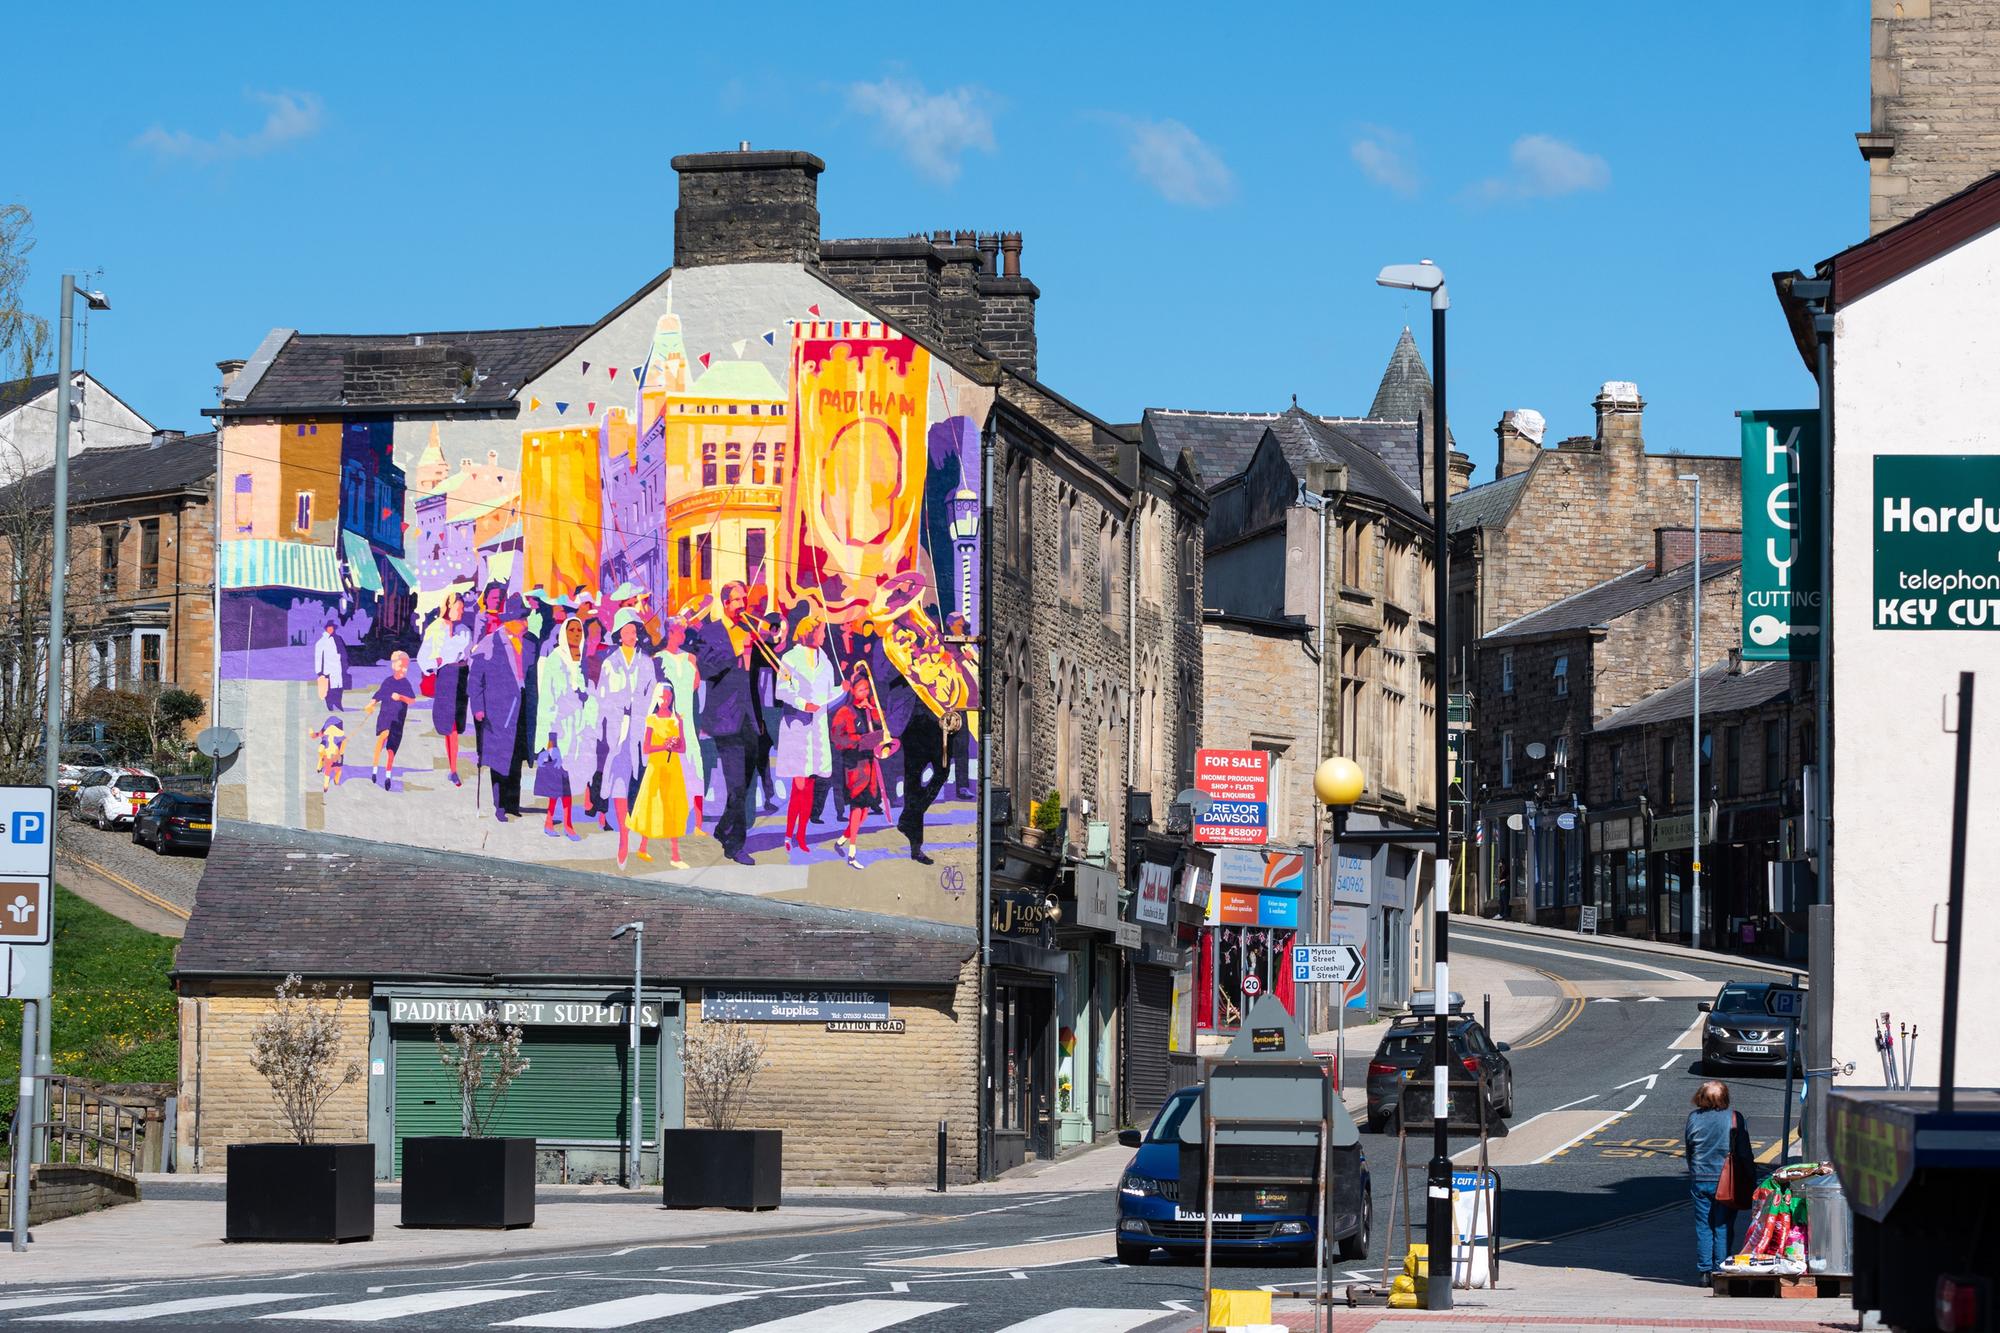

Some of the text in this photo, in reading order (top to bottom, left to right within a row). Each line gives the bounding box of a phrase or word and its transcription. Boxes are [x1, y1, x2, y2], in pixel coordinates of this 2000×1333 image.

[819, 388, 915, 416] PADIHAM
[1747, 591, 1821, 607] CUTTING
[1878, 598, 1938, 625] KEY
[1205, 756, 1262, 769] FOR SALE
[1227, 775, 1264, 783] PRODUCING
[1211, 803, 1259, 814] REVOR
[1203, 813, 1259, 824] DAWSON
[1199, 826, 1262, 837] 01282 458007
[1336, 875, 1365, 893] 540962
[1311, 948, 1337, 957] Mytton
[1245, 980, 1259, 990] 20
[716, 991, 777, 1003] Padiham
[781, 991, 804, 1004] Pet
[823, 991, 875, 1005] Wildlife
[503, 1003, 545, 1022] PET
[554, 1004, 653, 1025] SUPPLIS
[771, 1005, 820, 1017] Supplies
[829, 1021, 903, 1031] STATION ROAD
[1457, 1177, 1473, 1186] CUT
